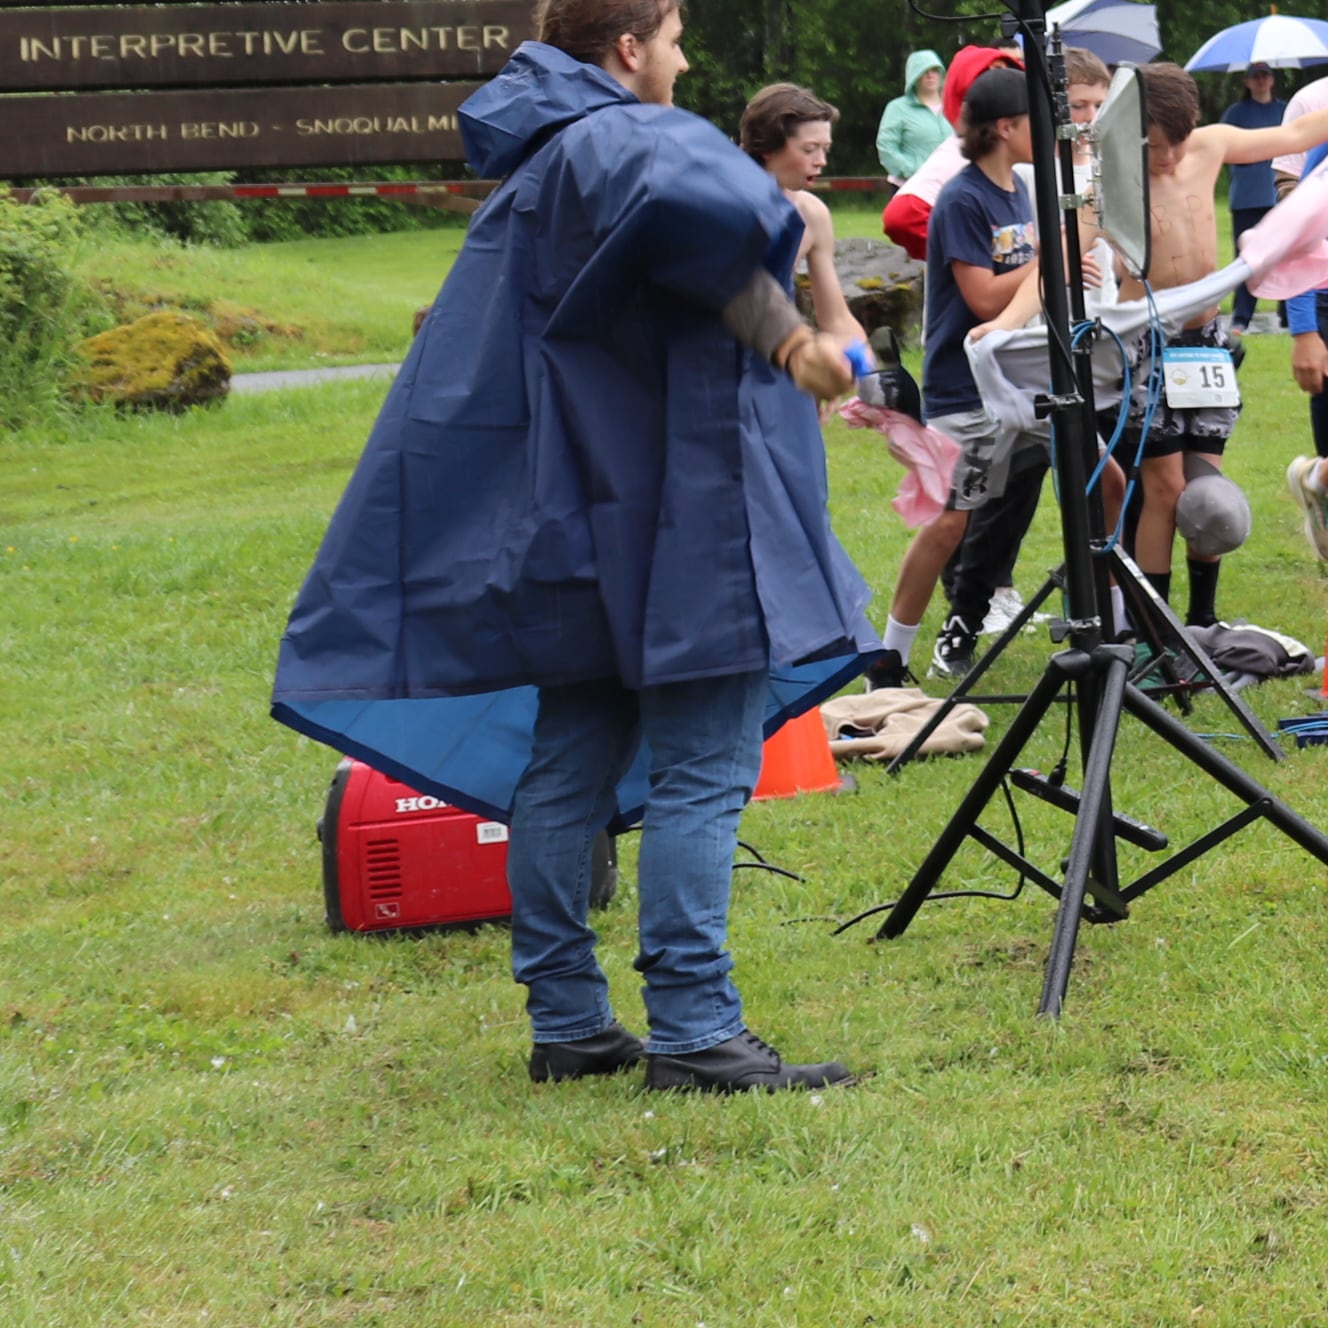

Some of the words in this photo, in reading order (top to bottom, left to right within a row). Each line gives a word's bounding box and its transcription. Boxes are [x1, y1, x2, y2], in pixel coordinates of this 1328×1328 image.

[20, 29, 325, 62] INTERPRETIVE
[342, 25, 510, 53] CENTER
[66, 123, 168, 143] NORTH
[180, 121, 260, 140] BEND
[295, 114, 458, 136] SNOQUALMI
[1199, 364, 1226, 388] 15
